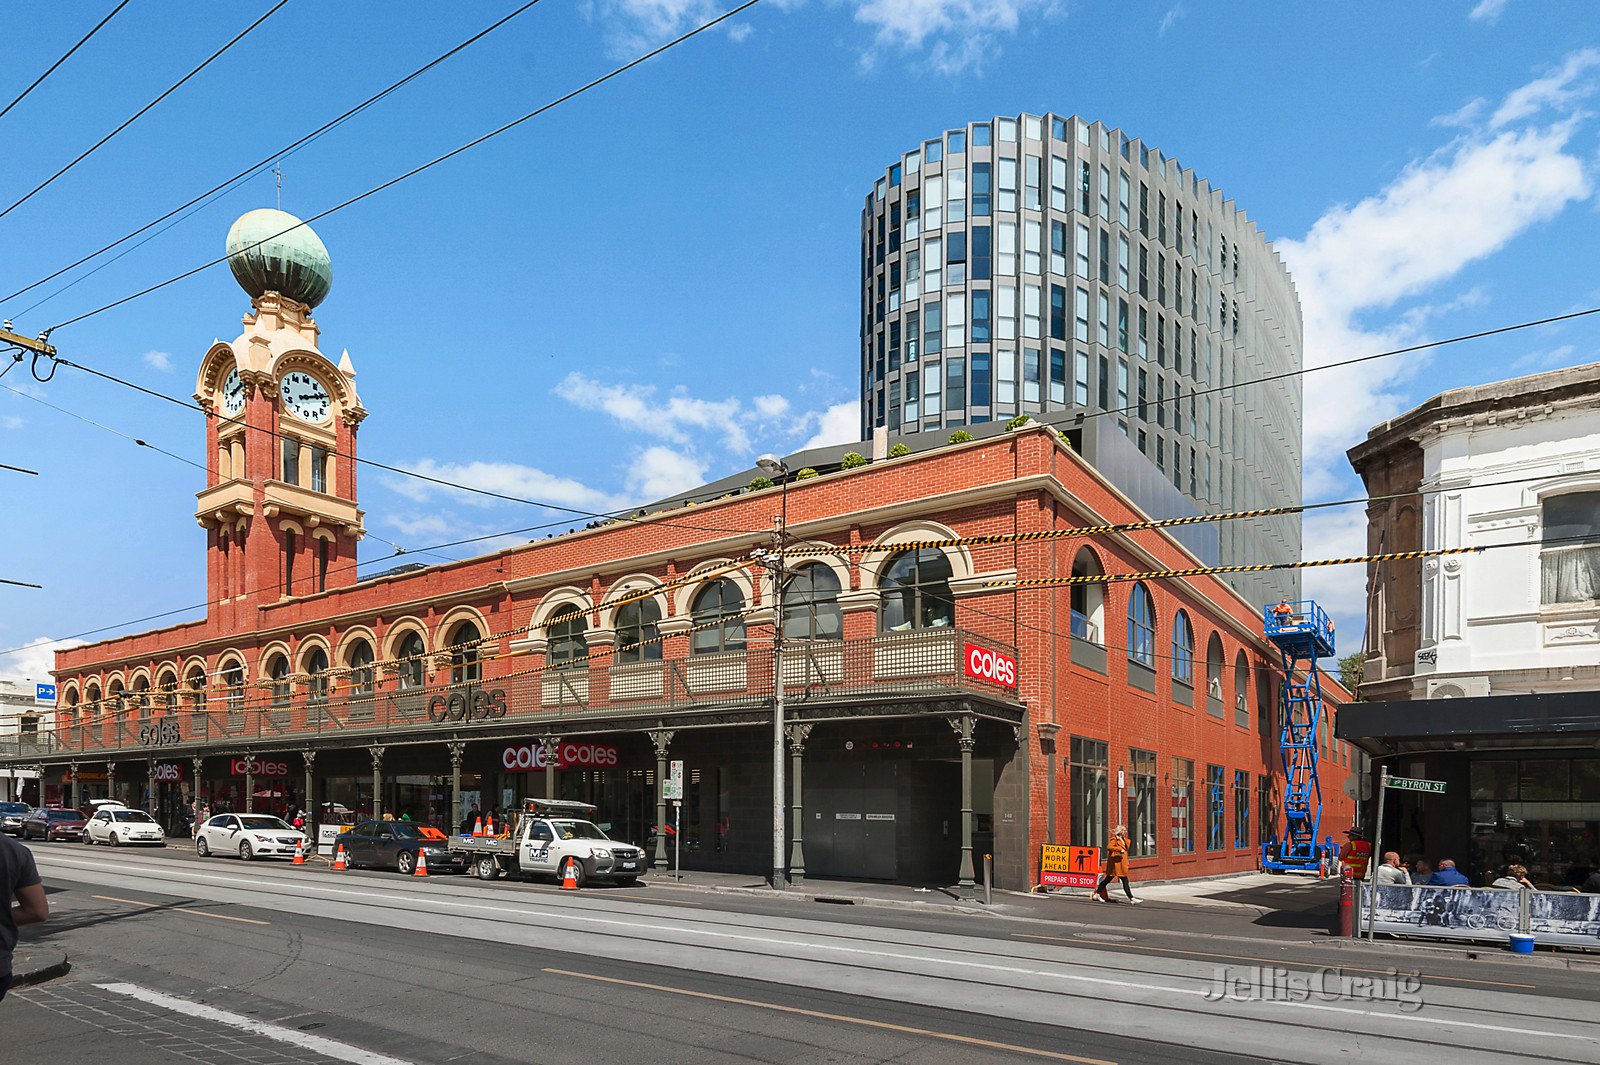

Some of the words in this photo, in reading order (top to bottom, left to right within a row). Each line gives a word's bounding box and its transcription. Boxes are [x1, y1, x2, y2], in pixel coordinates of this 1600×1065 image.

[971, 649, 1014, 685] coles
[38, 687, 45, 695] P
[428, 686, 507, 724] coles
[140, 717, 181, 747] coles
[502, 744, 561, 769] cole
[564, 745, 617, 765] coles
[235, 760, 287, 775] coles
[1401, 779, 1431, 790] BYRON
[1433, 783, 1445, 791] ST
[530, 848, 548, 858] MC
[1045, 846, 1067, 854] ROAD
[1044, 875, 1067, 883] PREPARE
